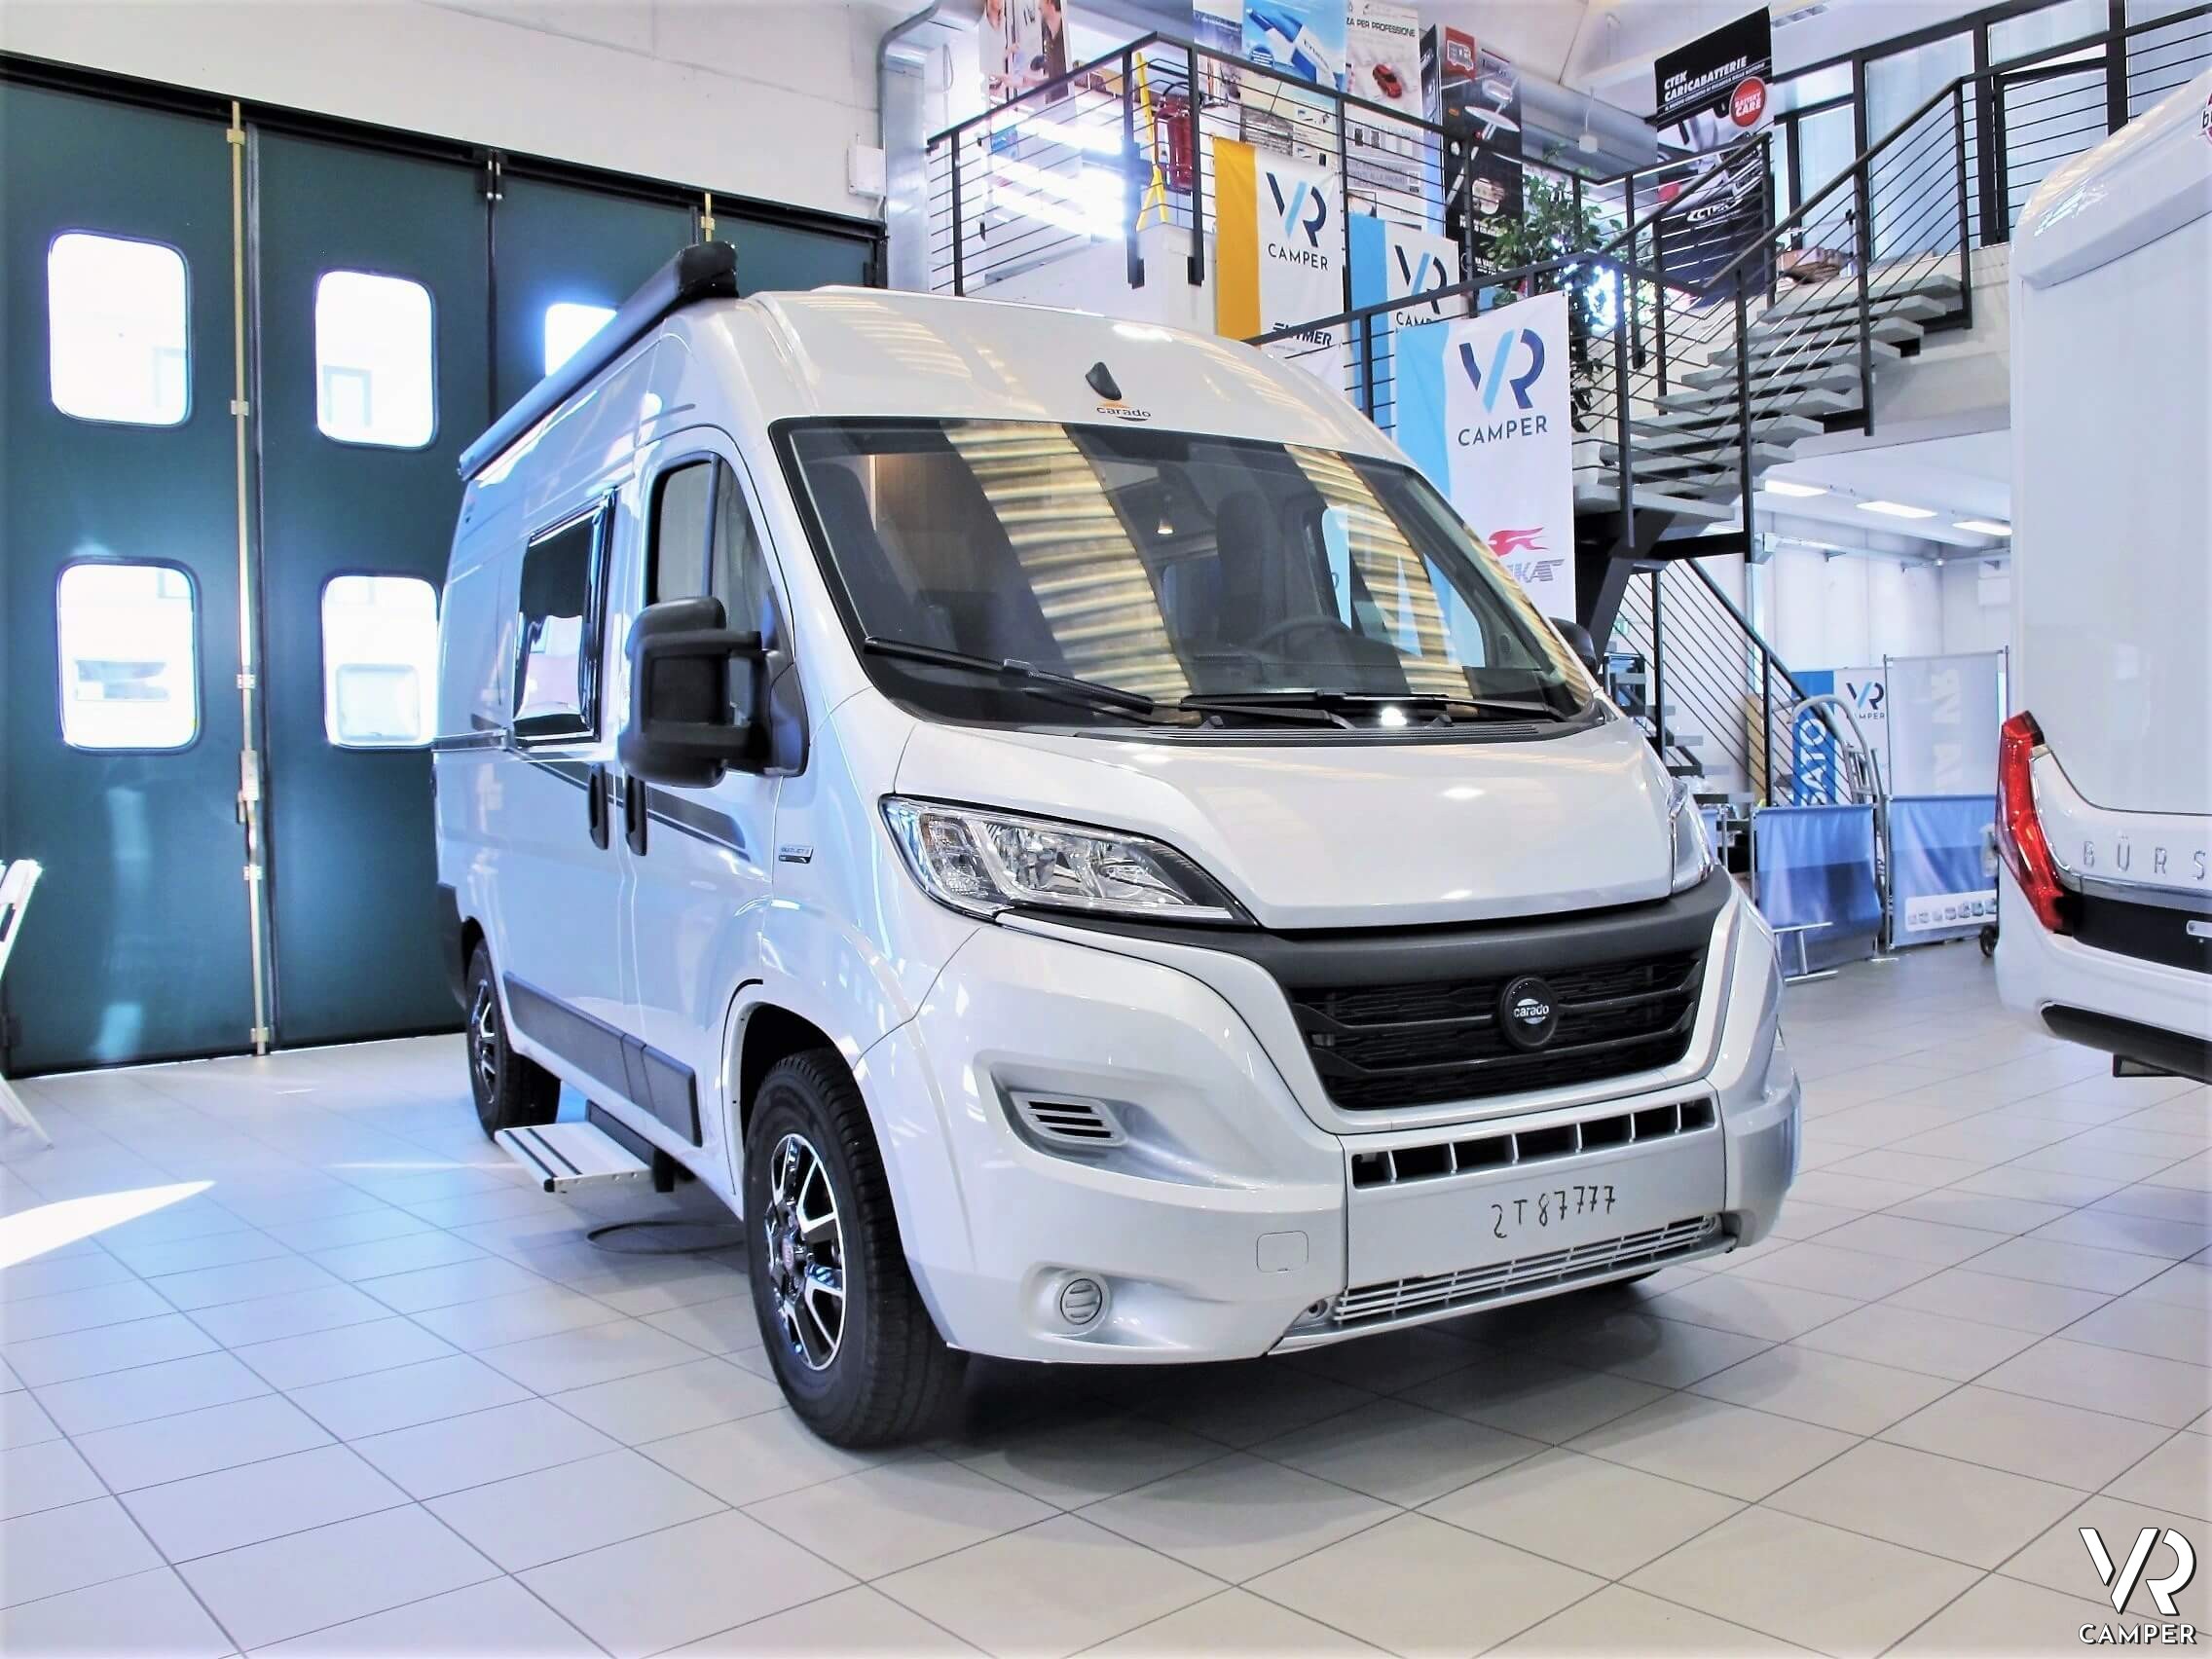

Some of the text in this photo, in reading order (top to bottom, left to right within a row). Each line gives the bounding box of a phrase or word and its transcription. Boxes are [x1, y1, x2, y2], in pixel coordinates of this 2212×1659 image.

[1357, 18, 1369, 28] PER
[1372, 21, 1416, 37] PROFESSIONE
[1664, 70, 1687, 90] CTEK
[1665, 55, 1748, 102] CARICABATTERIE
[1735, 98, 1761, 118] CARE
[1268, 242, 1328, 271] CAMPER
[1096, 406, 1151, 418] carado
[1458, 414, 1548, 447] CAMPER
[1513, 1003, 1550, 1018] carado
